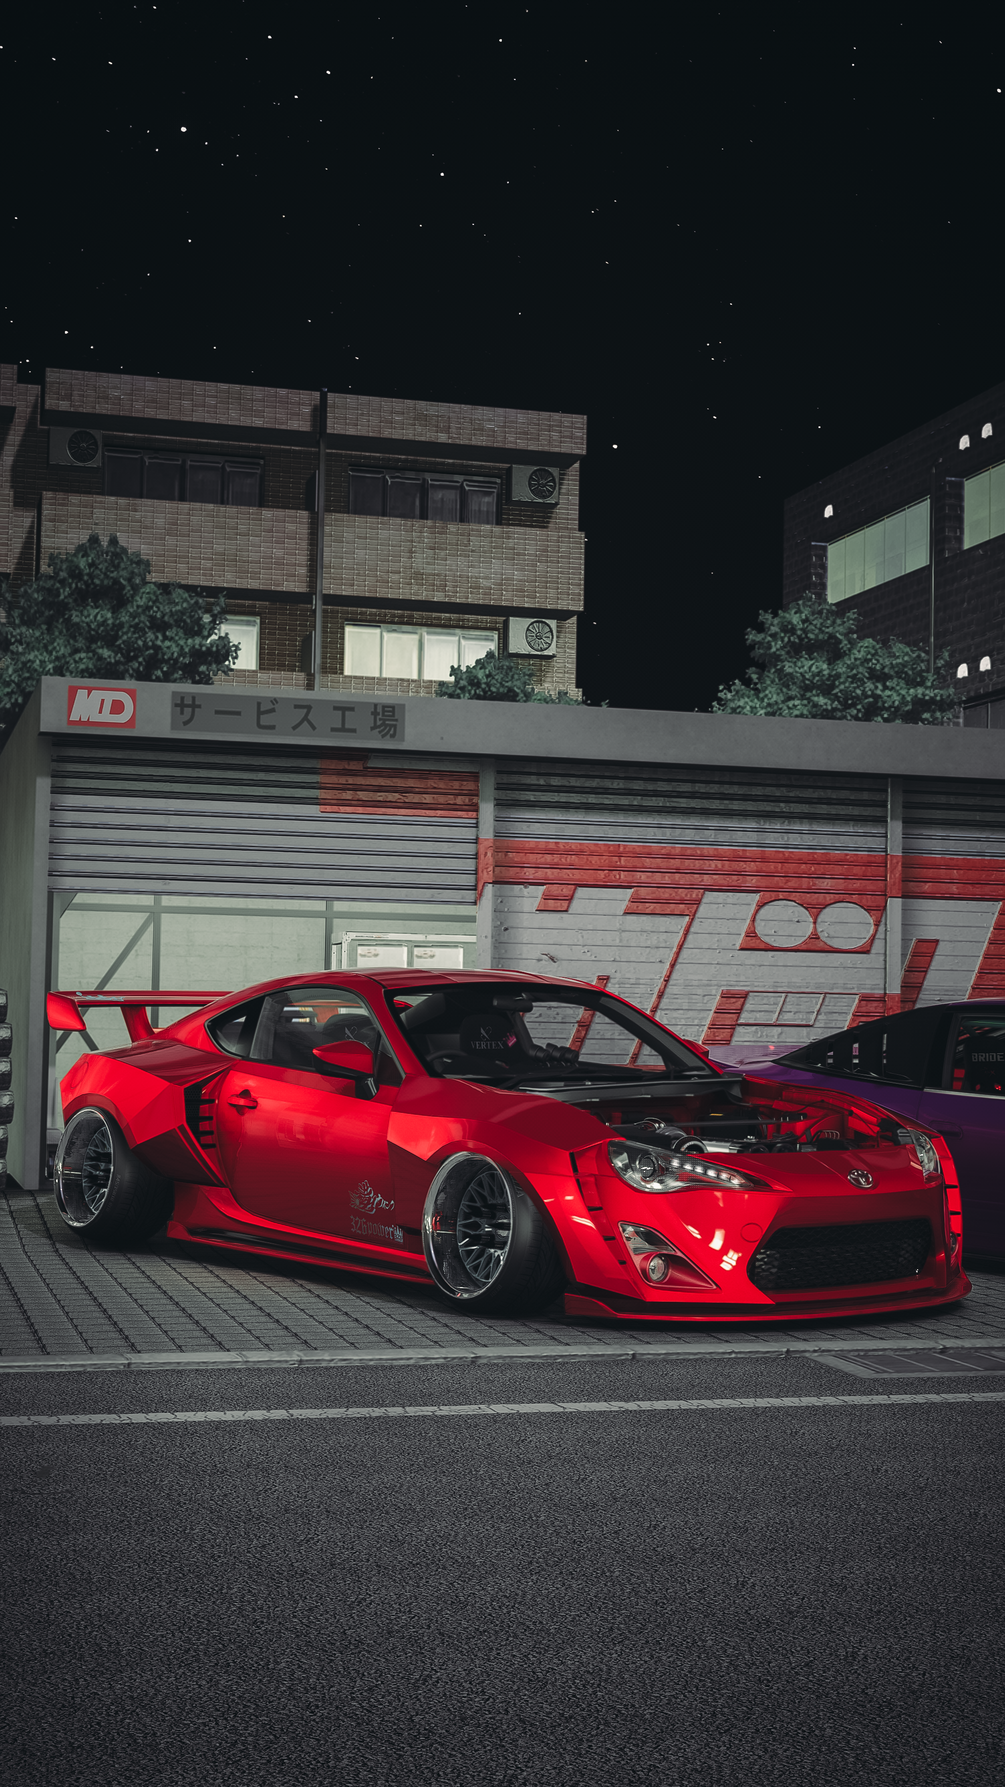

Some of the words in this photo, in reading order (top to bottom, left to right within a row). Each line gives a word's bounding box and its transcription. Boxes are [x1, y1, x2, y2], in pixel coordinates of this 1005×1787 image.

[174, 695, 399, 739] サービス工場
[470, 1040, 505, 1050] VERTEX
[971, 1052, 1005, 1062] BRIDE
